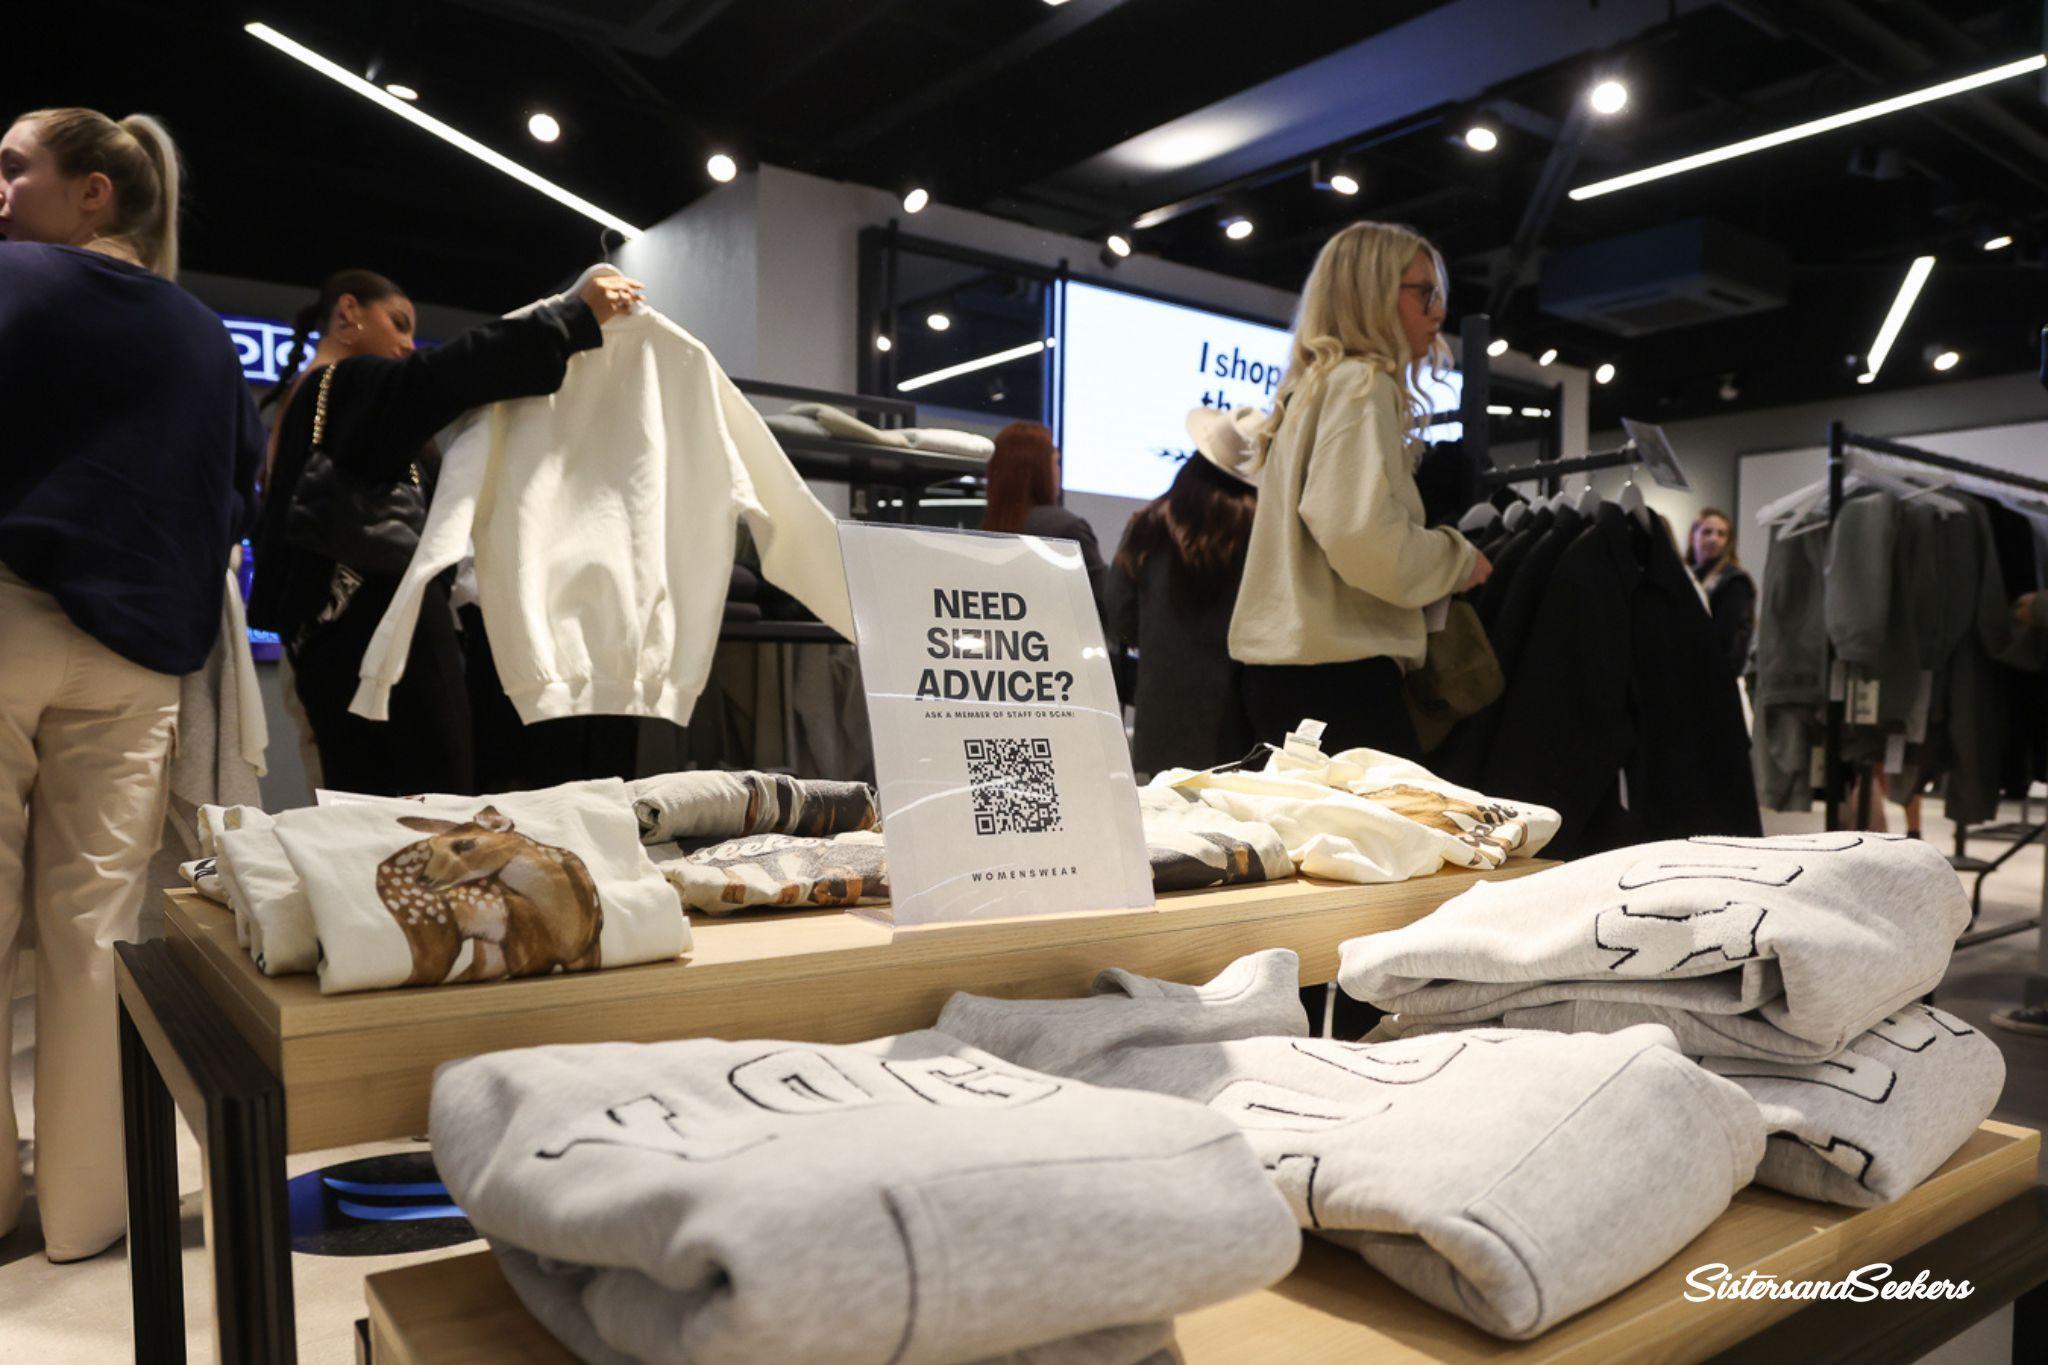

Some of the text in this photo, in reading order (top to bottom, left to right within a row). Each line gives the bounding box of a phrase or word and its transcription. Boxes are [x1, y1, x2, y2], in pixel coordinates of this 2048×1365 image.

[1200, 341, 1281, 395] I shop
[933, 588, 1027, 621] NEED
[926, 627, 1049, 662] SIZING
[915, 669, 1074, 702] ADVICE?
[924, 710, 943, 719] ASK
[954, 710, 991, 719] MEMBER
[992, 710, 1004, 719] OF
[1006, 710, 1032, 719] STAFF
[1034, 710, 1047, 719] OR
[971, 866, 1078, 882] WOMENSWEAR
